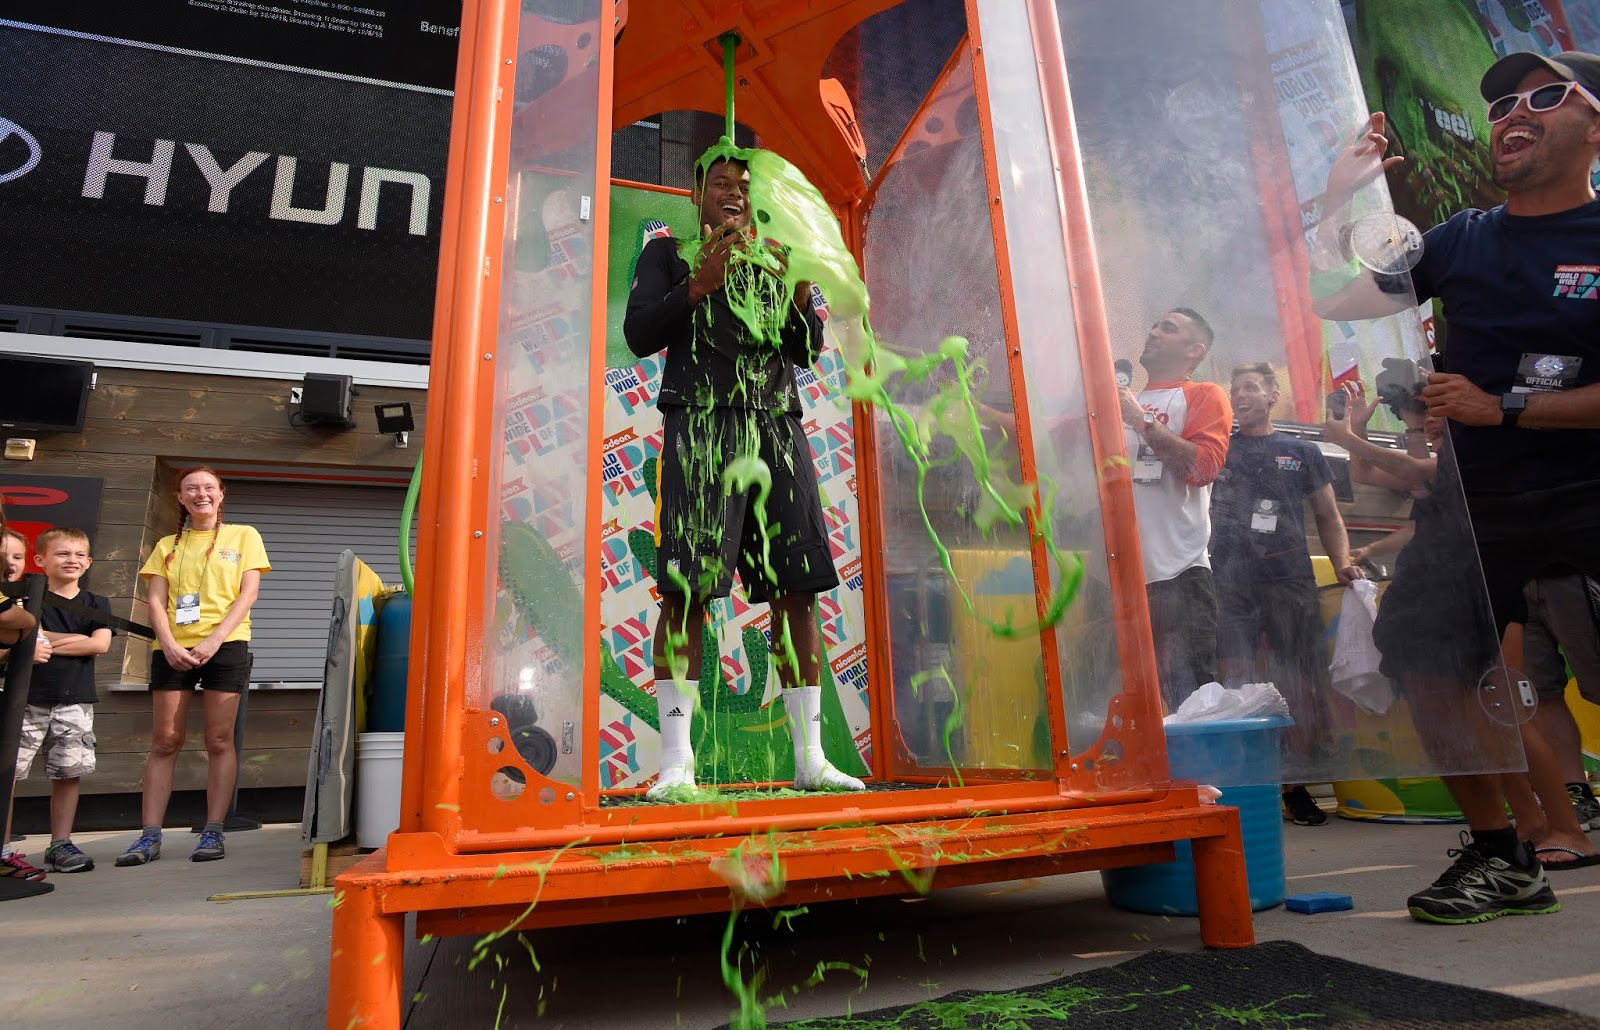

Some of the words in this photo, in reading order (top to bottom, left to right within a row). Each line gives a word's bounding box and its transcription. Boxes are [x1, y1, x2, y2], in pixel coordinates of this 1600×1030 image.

[81, 131, 431, 236] HYUN
[612, 376, 640, 394] WIDE
[1526, 376, 1563, 387] OFFICIAL
[616, 561, 631, 576] OF
